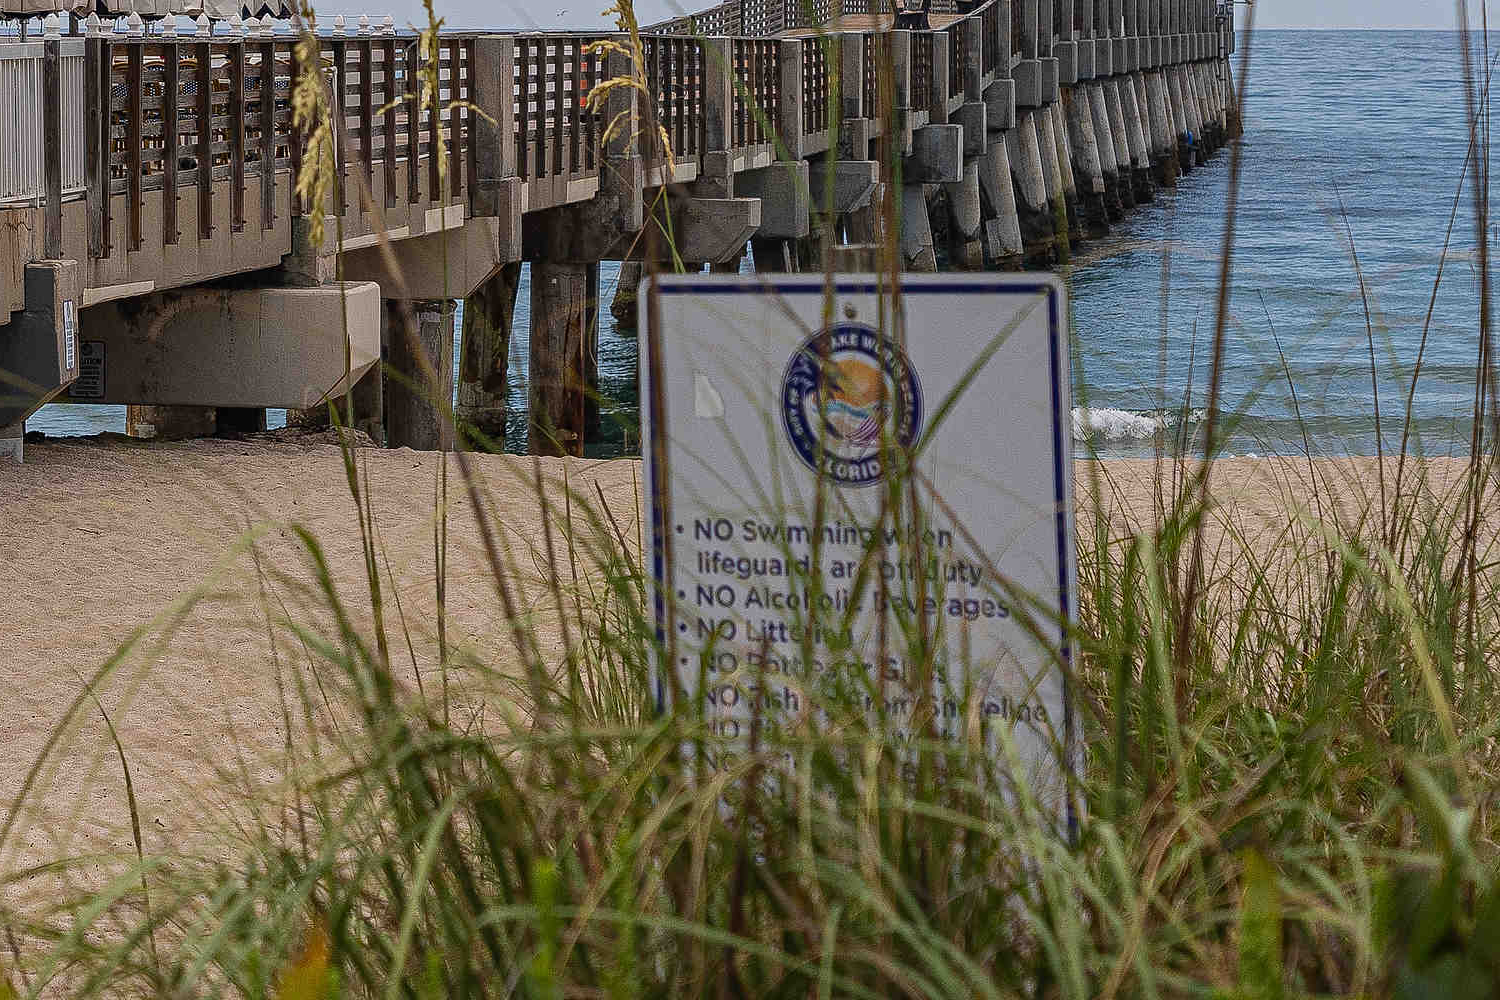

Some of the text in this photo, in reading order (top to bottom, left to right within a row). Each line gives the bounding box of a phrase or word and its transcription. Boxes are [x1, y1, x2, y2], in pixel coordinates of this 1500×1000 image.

[694, 518, 734, 542] NO
[698, 551, 816, 581] lifeguard
[830, 559, 861, 579] ar
[696, 584, 736, 608] NO
[874, 590, 1010, 622] Bveages
[696, 616, 854, 648] NO Littein
